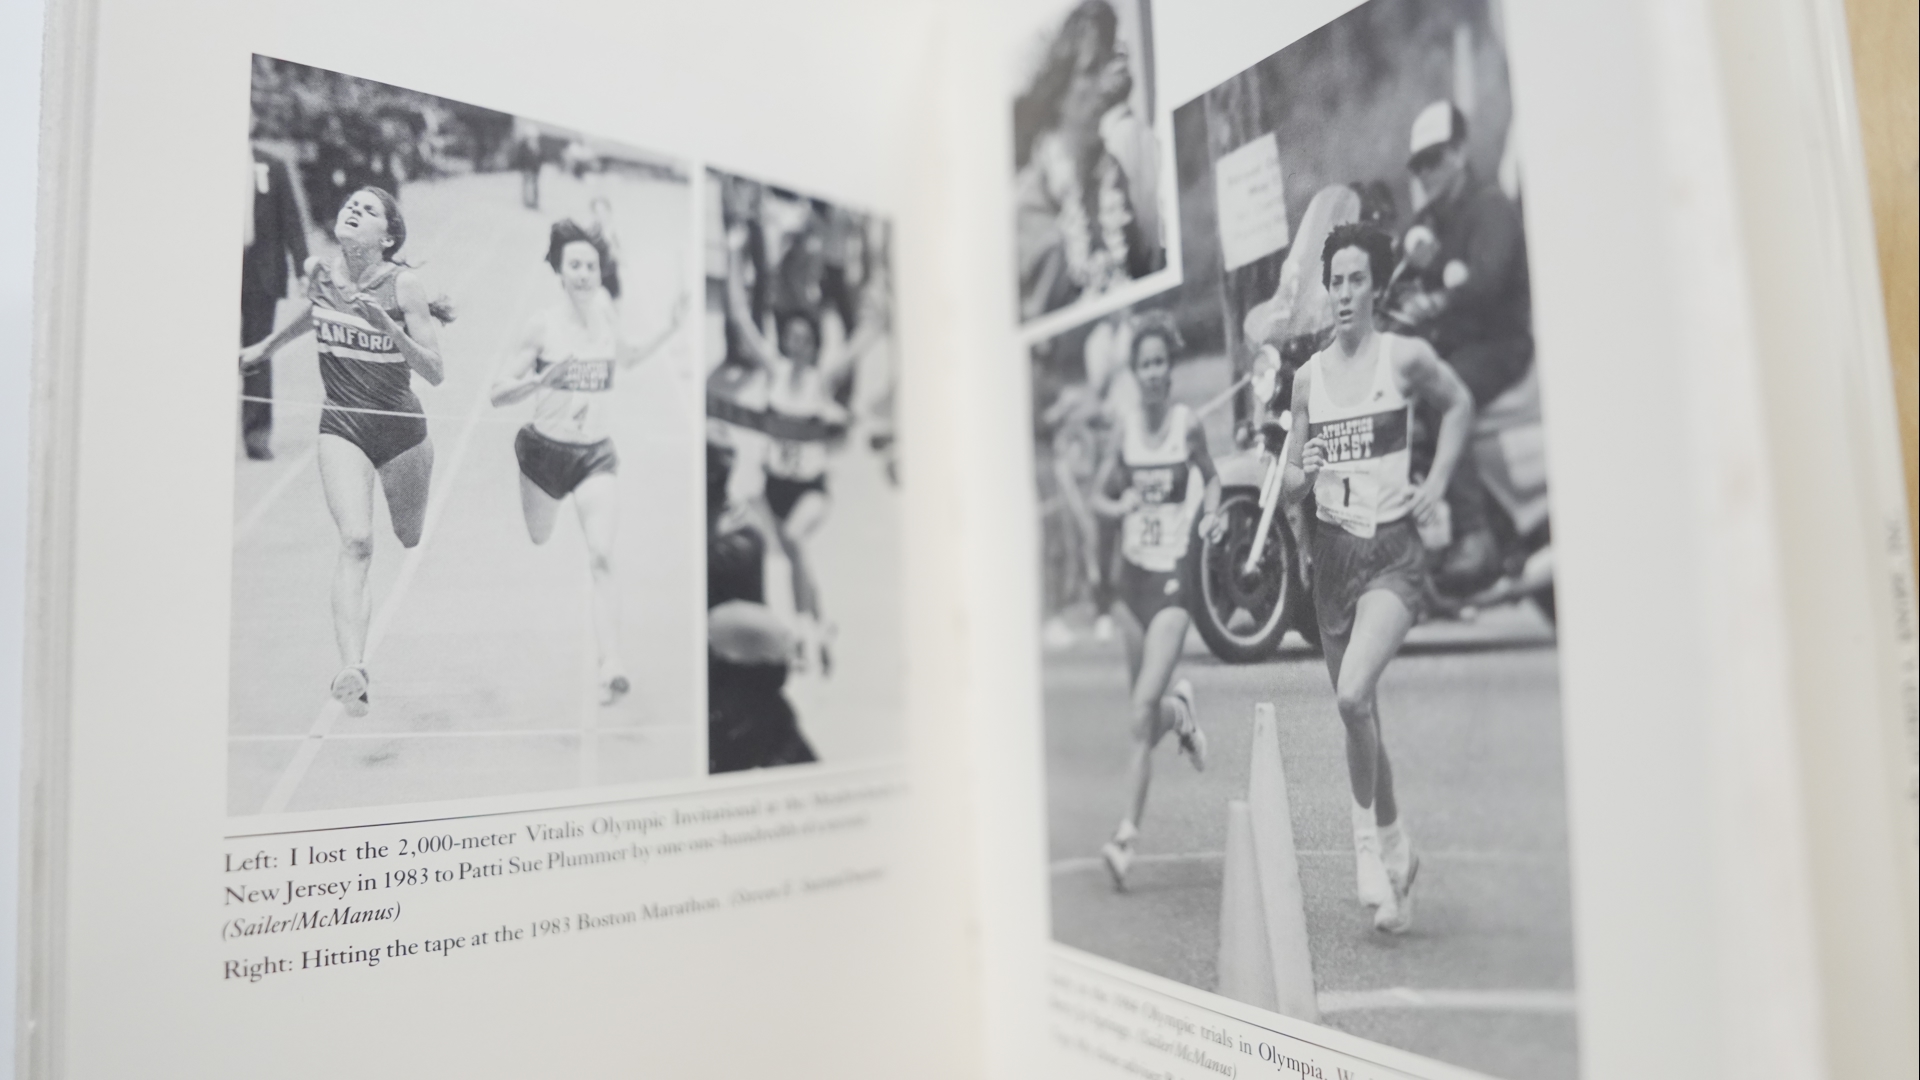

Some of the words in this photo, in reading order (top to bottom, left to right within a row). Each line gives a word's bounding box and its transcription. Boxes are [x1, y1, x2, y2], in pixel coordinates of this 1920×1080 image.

[1325, 432, 1374, 463] WEST
[1342, 477, 1350, 507] 1
[224, 850, 278, 873] Left:
[290, 848, 298, 867] I
[308, 846, 347, 866] lost
[356, 840, 389, 860] the
[398, 832, 516, 857] 2,000-meter
[526, 820, 584, 844] Vitalis
[592, 812, 665, 839] Olympic
[224, 884, 280, 906] New
[282, 879, 351, 906] Jersey
[357, 873, 377, 892] in
[384, 867, 428, 889] 1983
[435, 868, 454, 884] to
[458, 859, 503, 880] Patti
[508, 855, 543, 875] Sue
[547, 847, 628, 870] Plummer
[632, 841, 654, 864] by
[657, 840, 686, 856] one
[221, 901, 402, 941] (Sailer/McManus)
[224, 955, 293, 983] Right:
[301, 945, 381, 970] Hitting
[386, 938, 419, 958] the
[424, 935, 466, 957] tape
[471, 931, 489, 947] at
[494, 925, 524, 944] the
[530, 916, 571, 938] 1983
[577, 910, 637, 931] Boston
[641, 897, 722, 920] Marathon
[1200, 1025, 1233, 1049] trials
[1238, 1035, 1254, 1056] in
